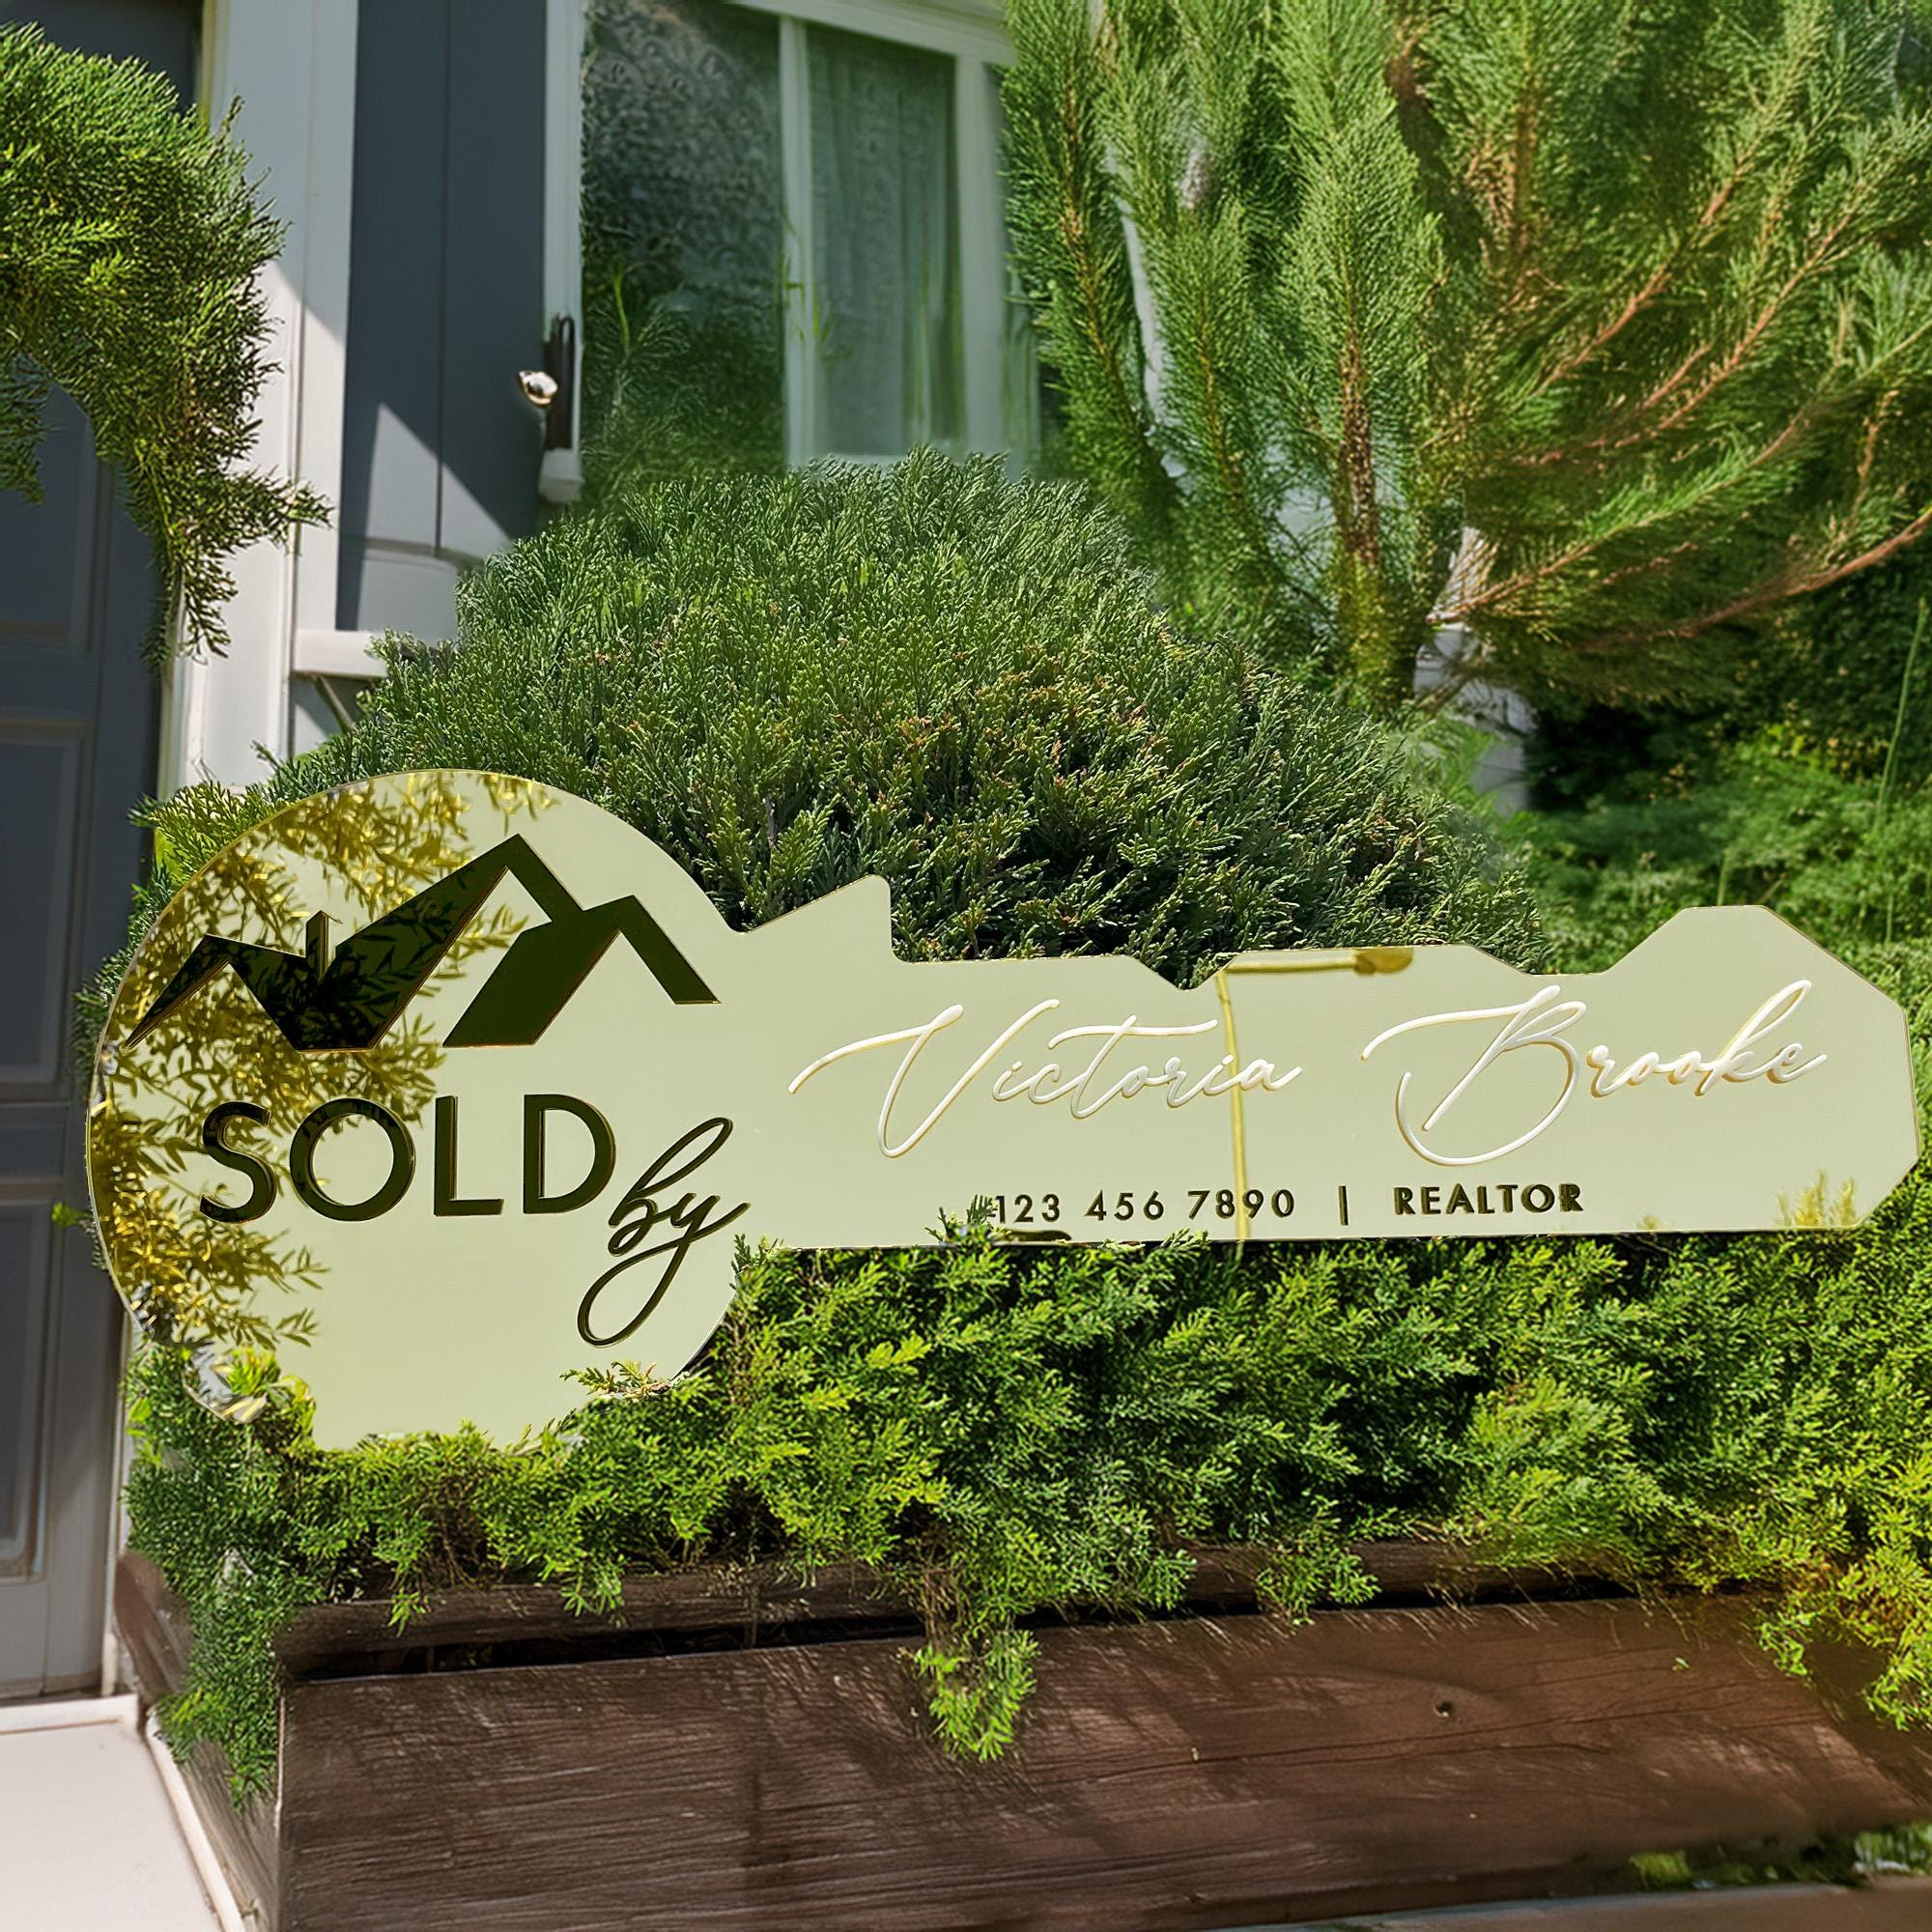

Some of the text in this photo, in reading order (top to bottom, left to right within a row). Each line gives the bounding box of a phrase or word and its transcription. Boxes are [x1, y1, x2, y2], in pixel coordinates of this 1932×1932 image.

[788, 979, 1829, 1168] Victoria Brooke
[199, 1094, 751, 1349] SOLD by
[993, 1193, 1061, 1224] 123
[1083, 1189, 1165, 1222] 456
[1187, 1188, 1295, 1220] 7890
[1392, 1181, 1584, 1215] REALTOR
